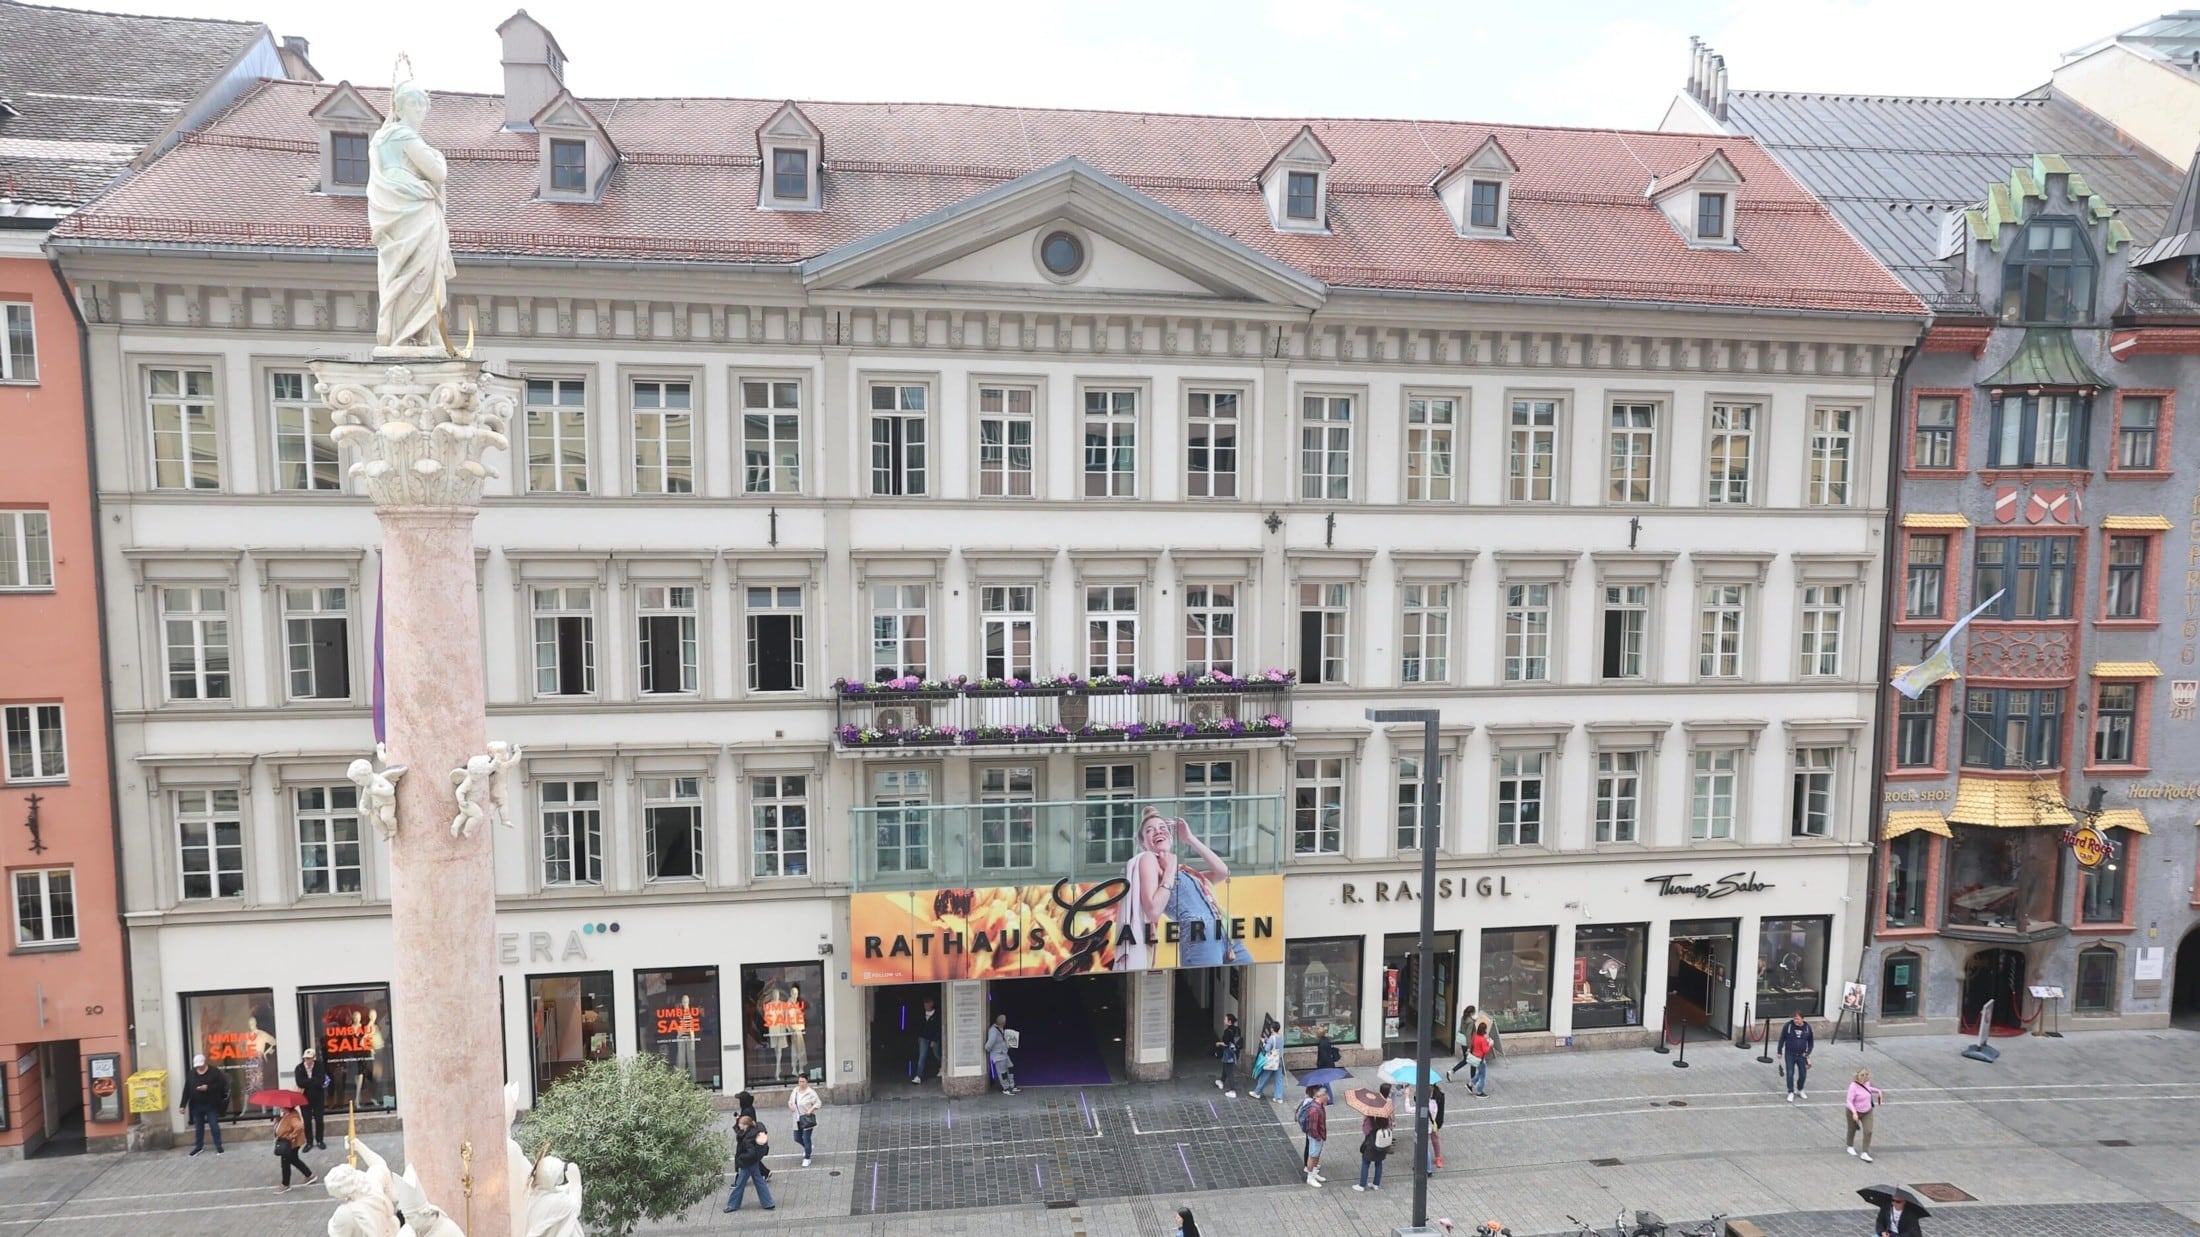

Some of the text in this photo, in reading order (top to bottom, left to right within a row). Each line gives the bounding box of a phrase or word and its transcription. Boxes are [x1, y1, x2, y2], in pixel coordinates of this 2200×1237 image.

[1884, 790, 1952, 802] ROCK SHOP
[2128, 783, 2163, 799] Hard
[2163, 783, 2195, 801] Rock
[2063, 829, 2115, 859] Hard Rock
[1342, 876, 1512, 904] R. RASIGL
[1644, 871, 1776, 899] Thomas Sabo
[864, 877, 1273, 981] RATHAUS GALERIEN
[499, 929, 588, 964] ERA
[85, 1004, 104, 1016] 20
[656, 1007, 700, 1018] UMBAU
[762, 1001, 805, 1011] UMBAU
[657, 1019, 701, 1034] SALE
[763, 1011, 805, 1028] SALE
[208, 1032, 257, 1043] UMBAU
[326, 1024, 373, 1037] UMBAU
[209, 1043, 257, 1060] SALE
[327, 1036, 373, 1053] SALE
